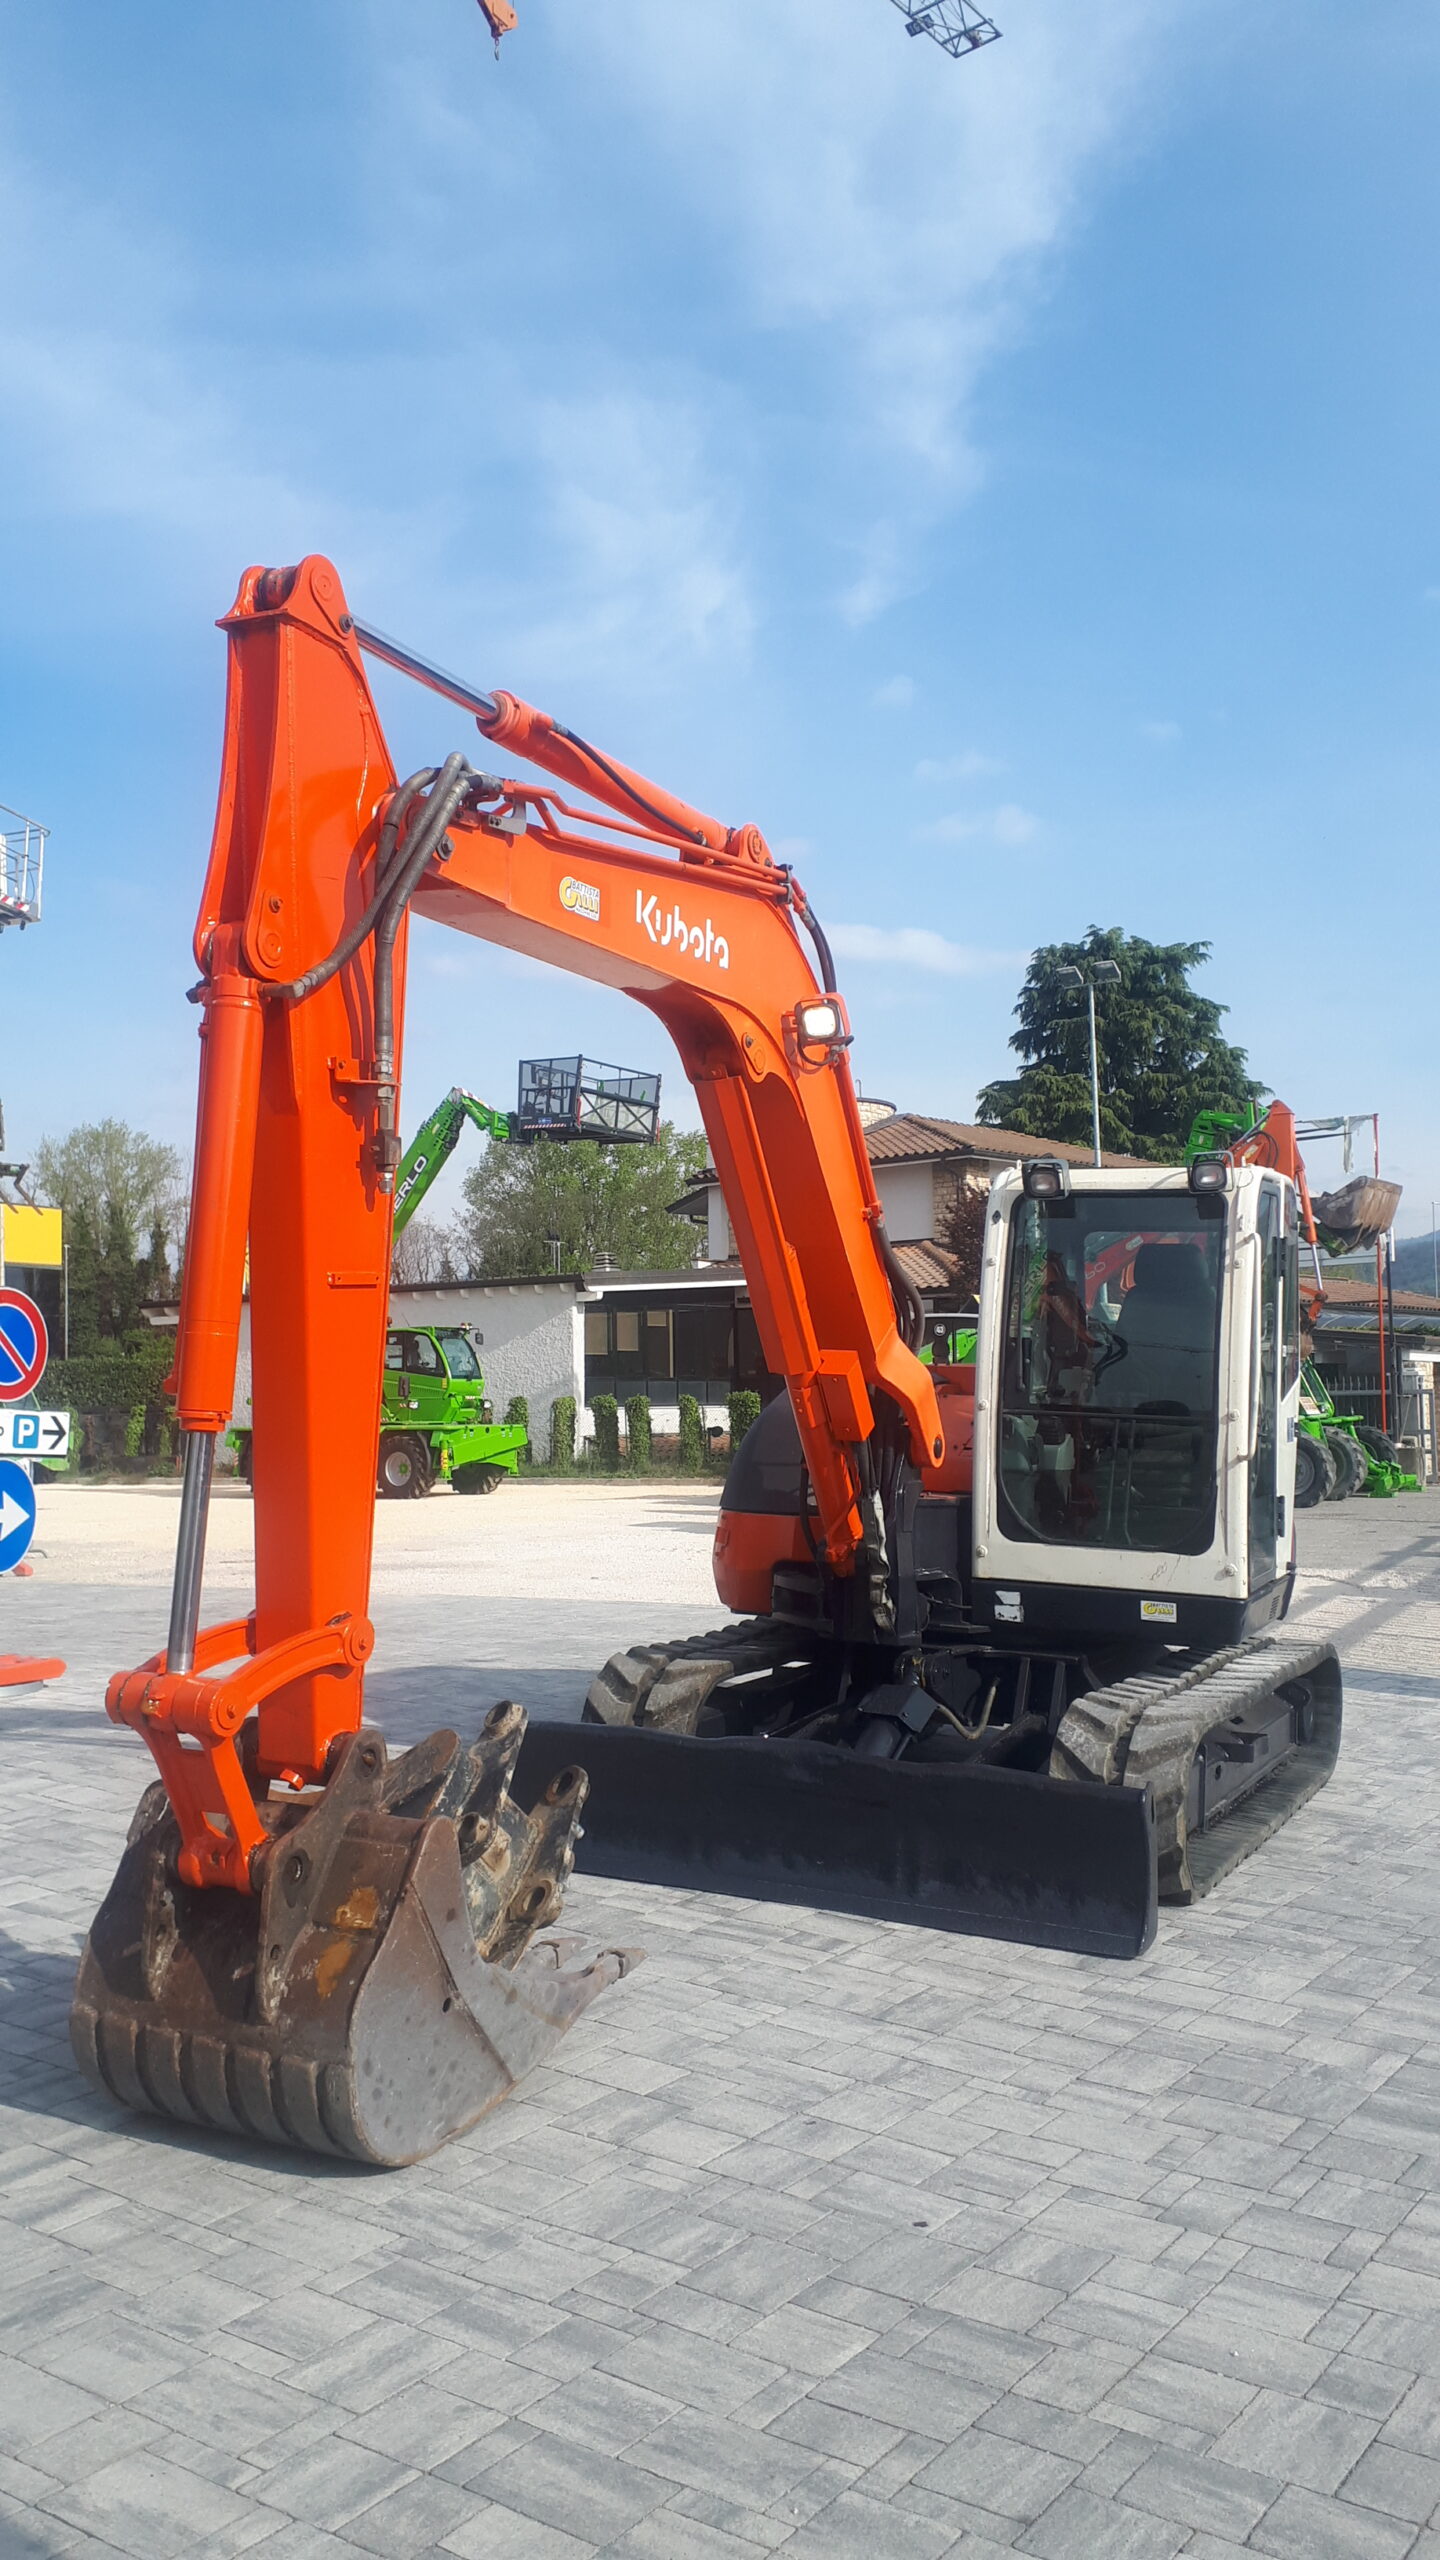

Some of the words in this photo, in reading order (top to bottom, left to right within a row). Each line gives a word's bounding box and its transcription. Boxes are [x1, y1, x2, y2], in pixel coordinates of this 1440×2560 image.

[571, 880, 599, 898] BATTISTA
[635, 888, 730, 970] Kubota
[393, 1154, 428, 1215] ERLO
[17, 1418, 36, 1445] P
